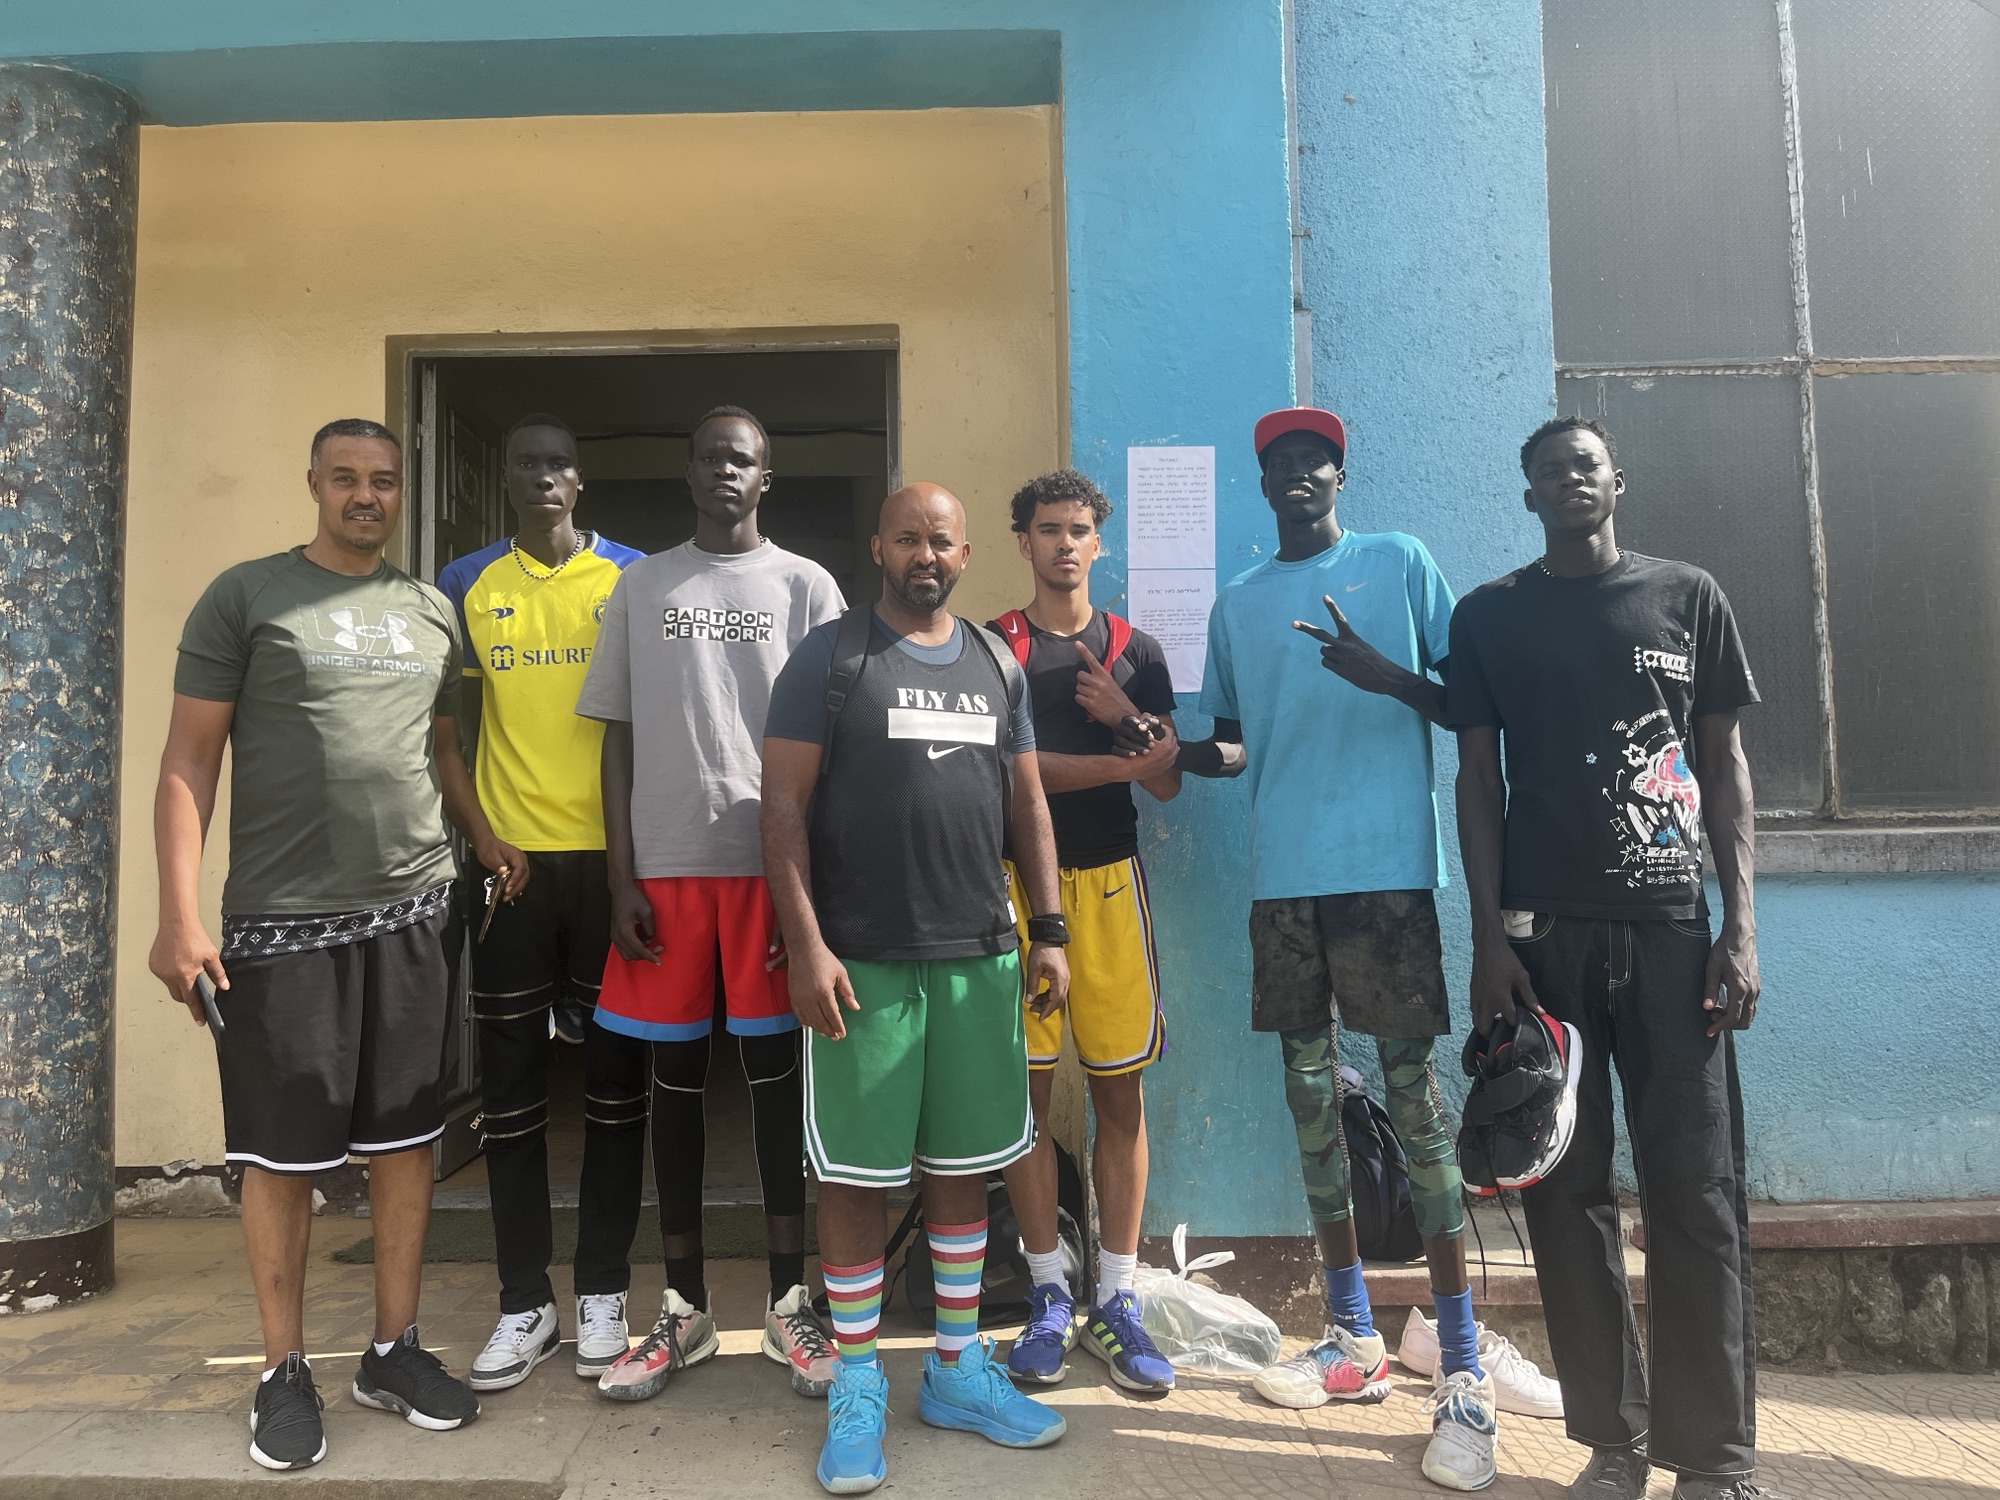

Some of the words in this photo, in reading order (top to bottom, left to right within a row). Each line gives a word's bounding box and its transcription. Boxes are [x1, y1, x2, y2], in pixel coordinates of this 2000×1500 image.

[664, 608, 773, 628] CARTOON
[664, 623, 772, 642] NETWORK
[303, 654, 367, 669] UNDER
[897, 687, 947, 711] FLY
[955, 693, 989, 714] AS
